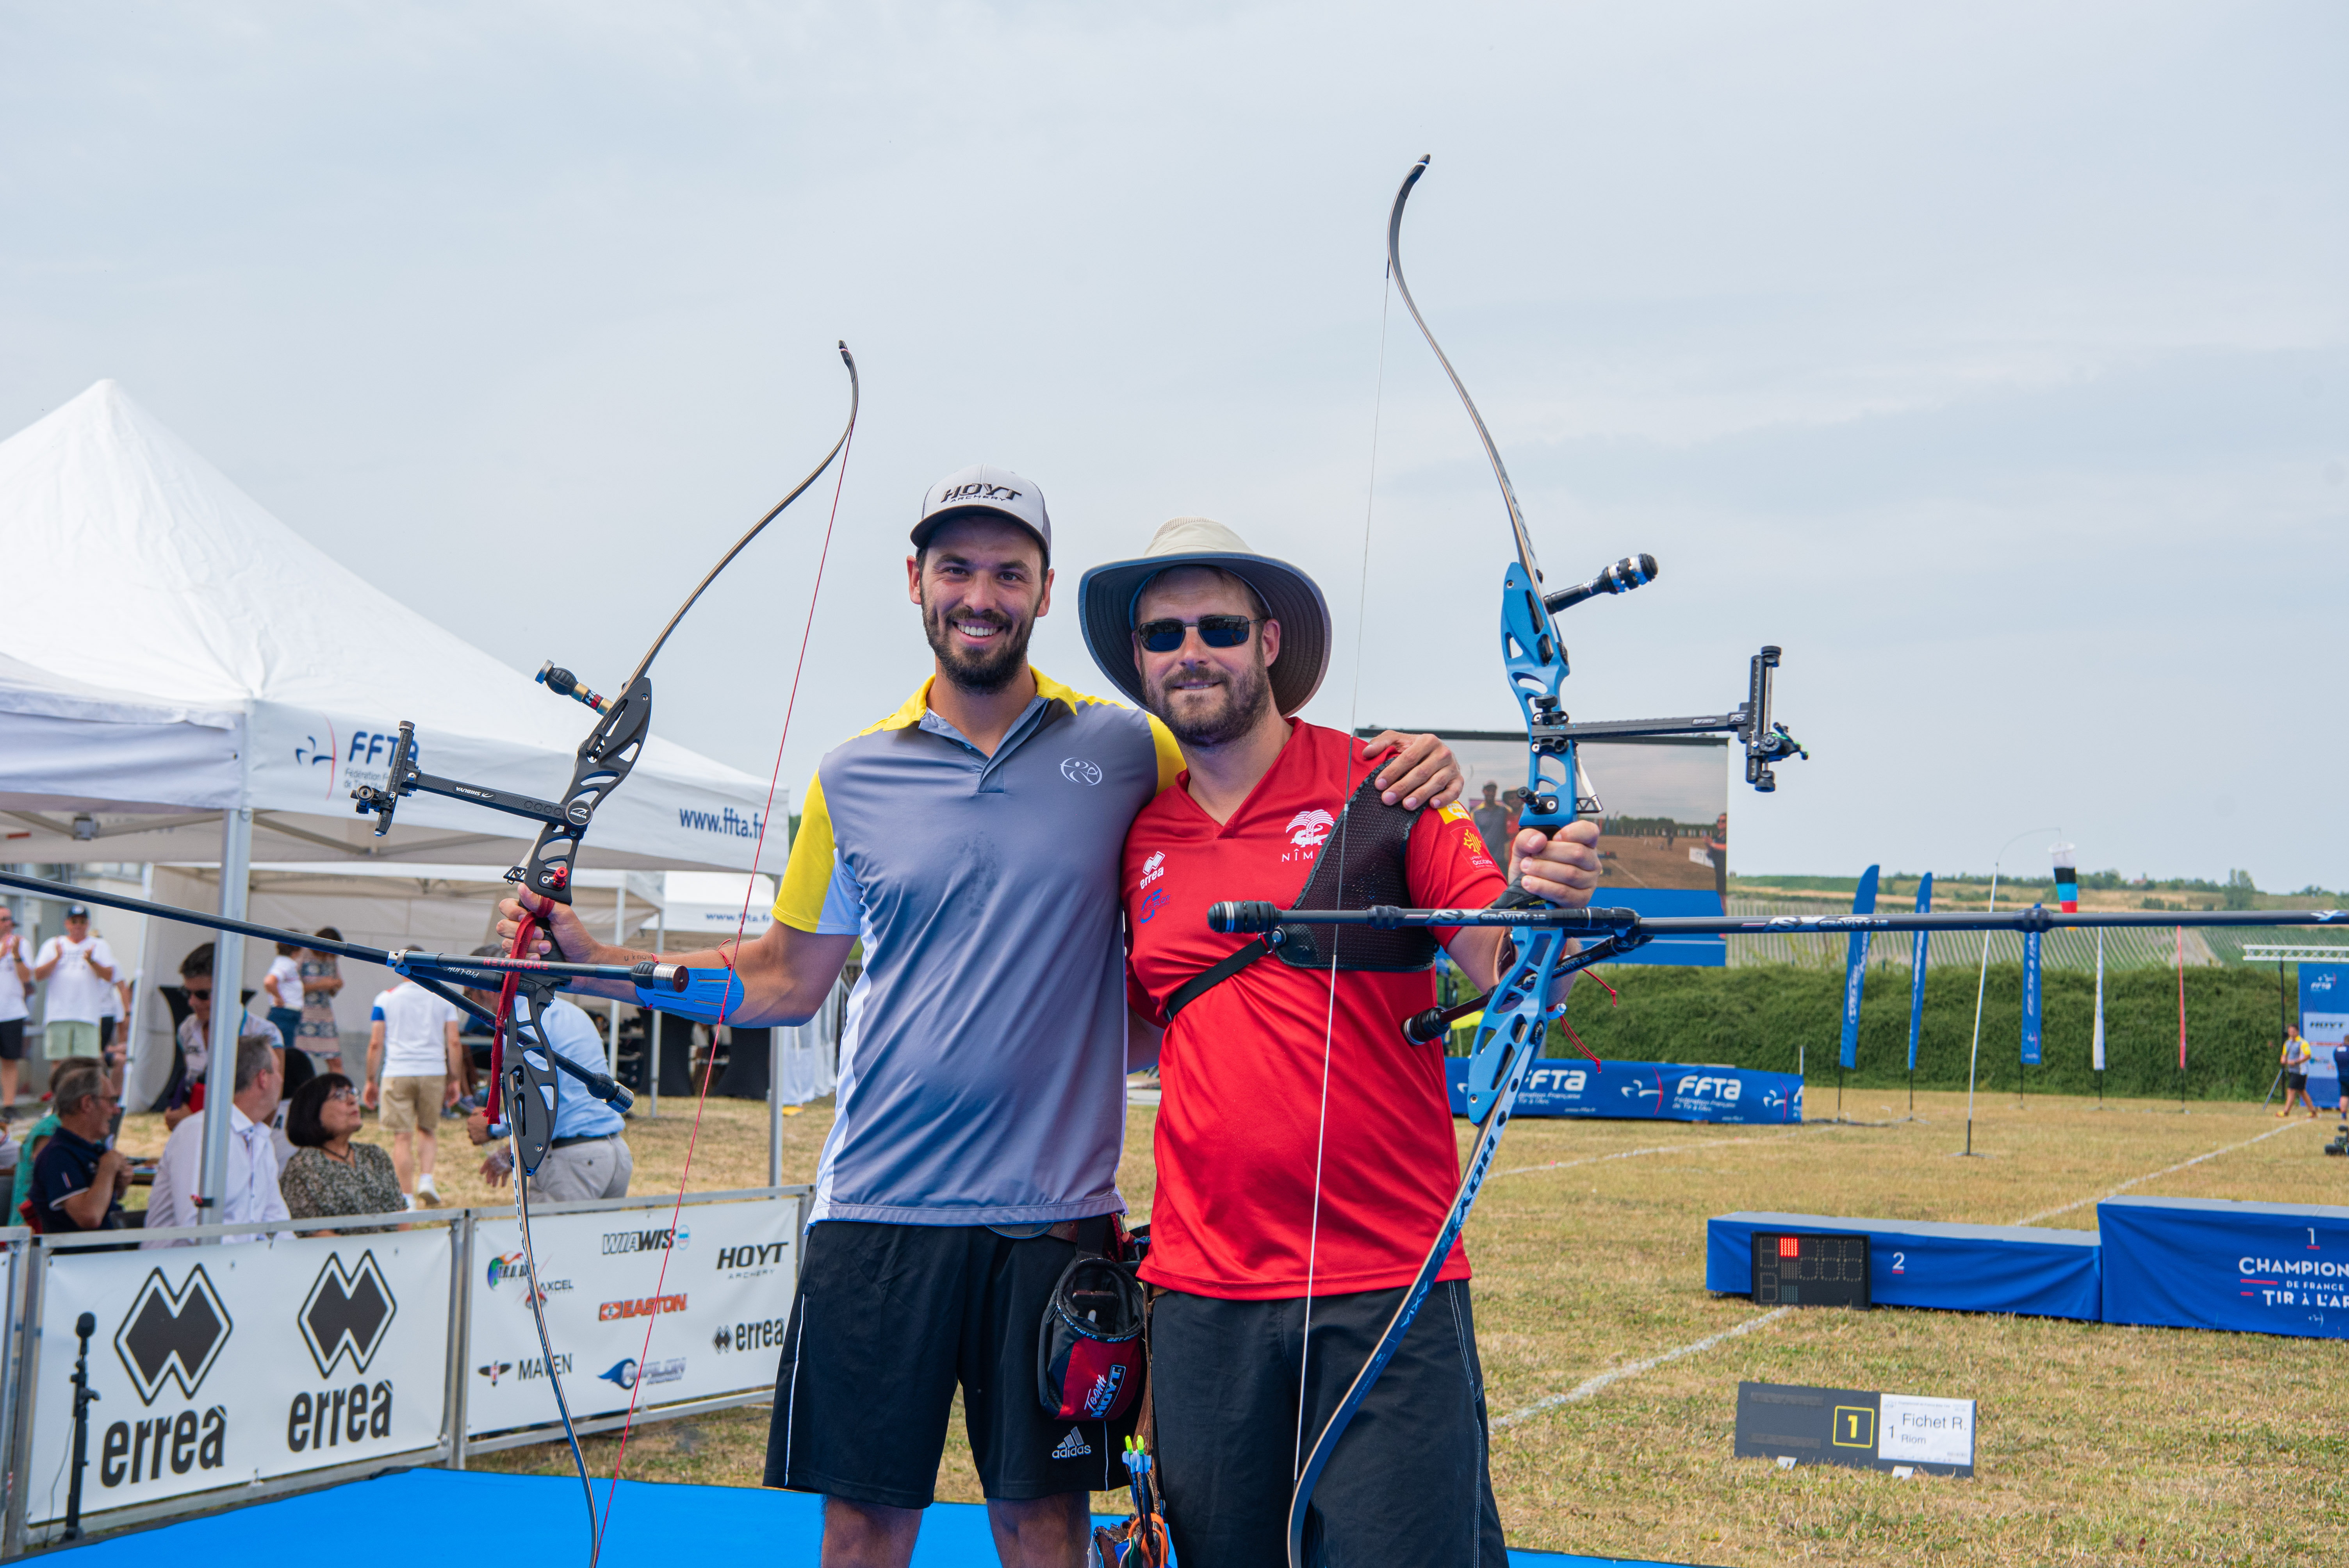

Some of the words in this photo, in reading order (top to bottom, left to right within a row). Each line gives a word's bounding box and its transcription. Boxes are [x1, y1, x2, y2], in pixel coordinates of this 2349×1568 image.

[941, 483, 1022, 503] HOYT
[950, 495, 1006, 503] ARCHERY
[349, 731, 419, 768] FFTA
[456, 786, 481, 796] SHIBUYA
[570, 811, 587, 820] SHIBUYA
[679, 807, 764, 839] www.ffta.fr
[447, 966, 480, 978] Pro-Link
[483, 957, 550, 970] HEXAGONE
[1677, 1075, 1742, 1101] FFTA
[602, 1228, 677, 1255] WIAWIS
[2307, 1227, 2315, 1245] 1
[716, 1241, 790, 1270] HOYT
[1893, 1251, 1905, 1270] 2
[728, 1269, 775, 1279] ARCHERY
[2239, 1256, 2349, 1278] CHAMPION
[2286, 1280, 2299, 1289] DE
[2303, 1281, 2345, 1292] FRANCE
[622, 1293, 687, 1319] EASTON
[2262, 1289, 2294, 1306] TIR
[1084, 1374, 1107, 1411] Team
[1093, 1367, 1121, 1416] HOYT
[1848, 1415, 1858, 1439] 1
[1903, 1412, 1947, 1429] Fichet
[1953, 1417, 1967, 1431] R.
[1888, 1425, 1894, 1438] 1
[1901, 1433, 1926, 1445] Riom
[1052, 1445, 1092, 1459] adidas
